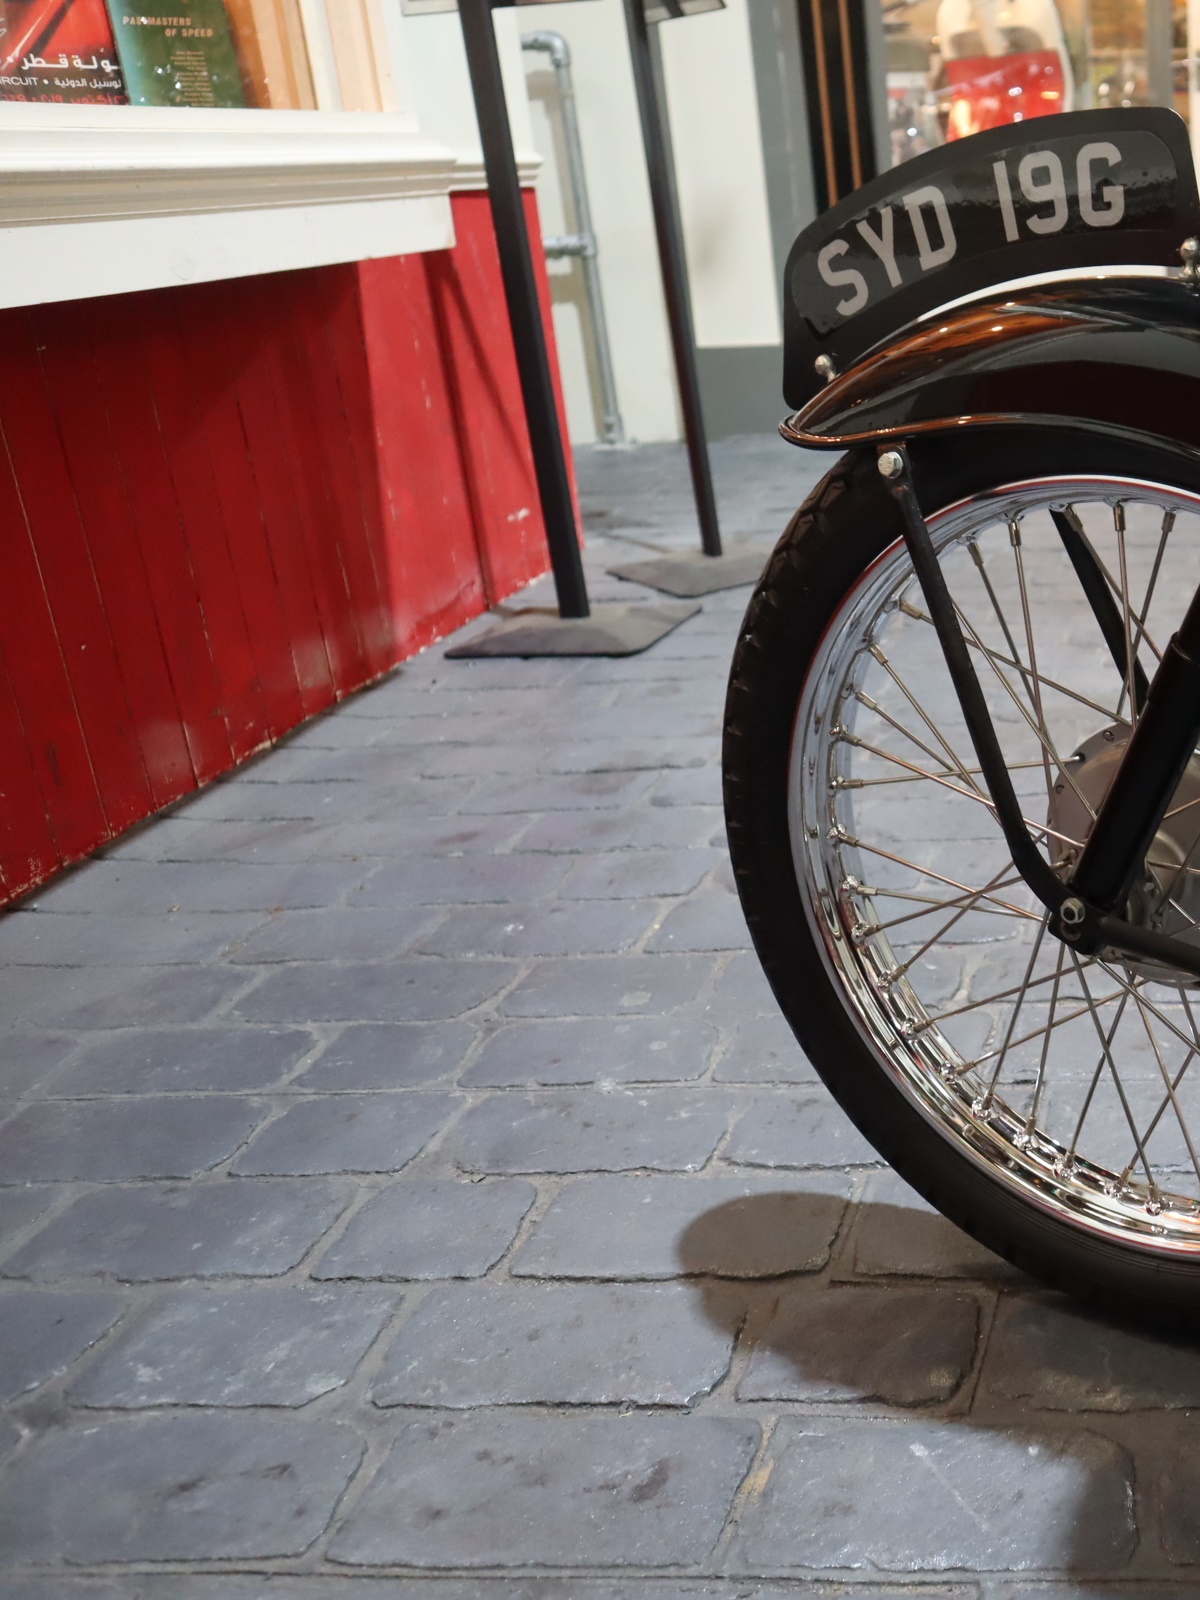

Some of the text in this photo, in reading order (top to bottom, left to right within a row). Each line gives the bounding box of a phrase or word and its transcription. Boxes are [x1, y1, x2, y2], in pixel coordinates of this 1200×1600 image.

[123, 16, 192, 26] PASMASTERS
[165, 28, 214, 38] OF SPEED
[21, 53, 69, 71] قطر
[816, 141, 1126, 317] SYD 19G
